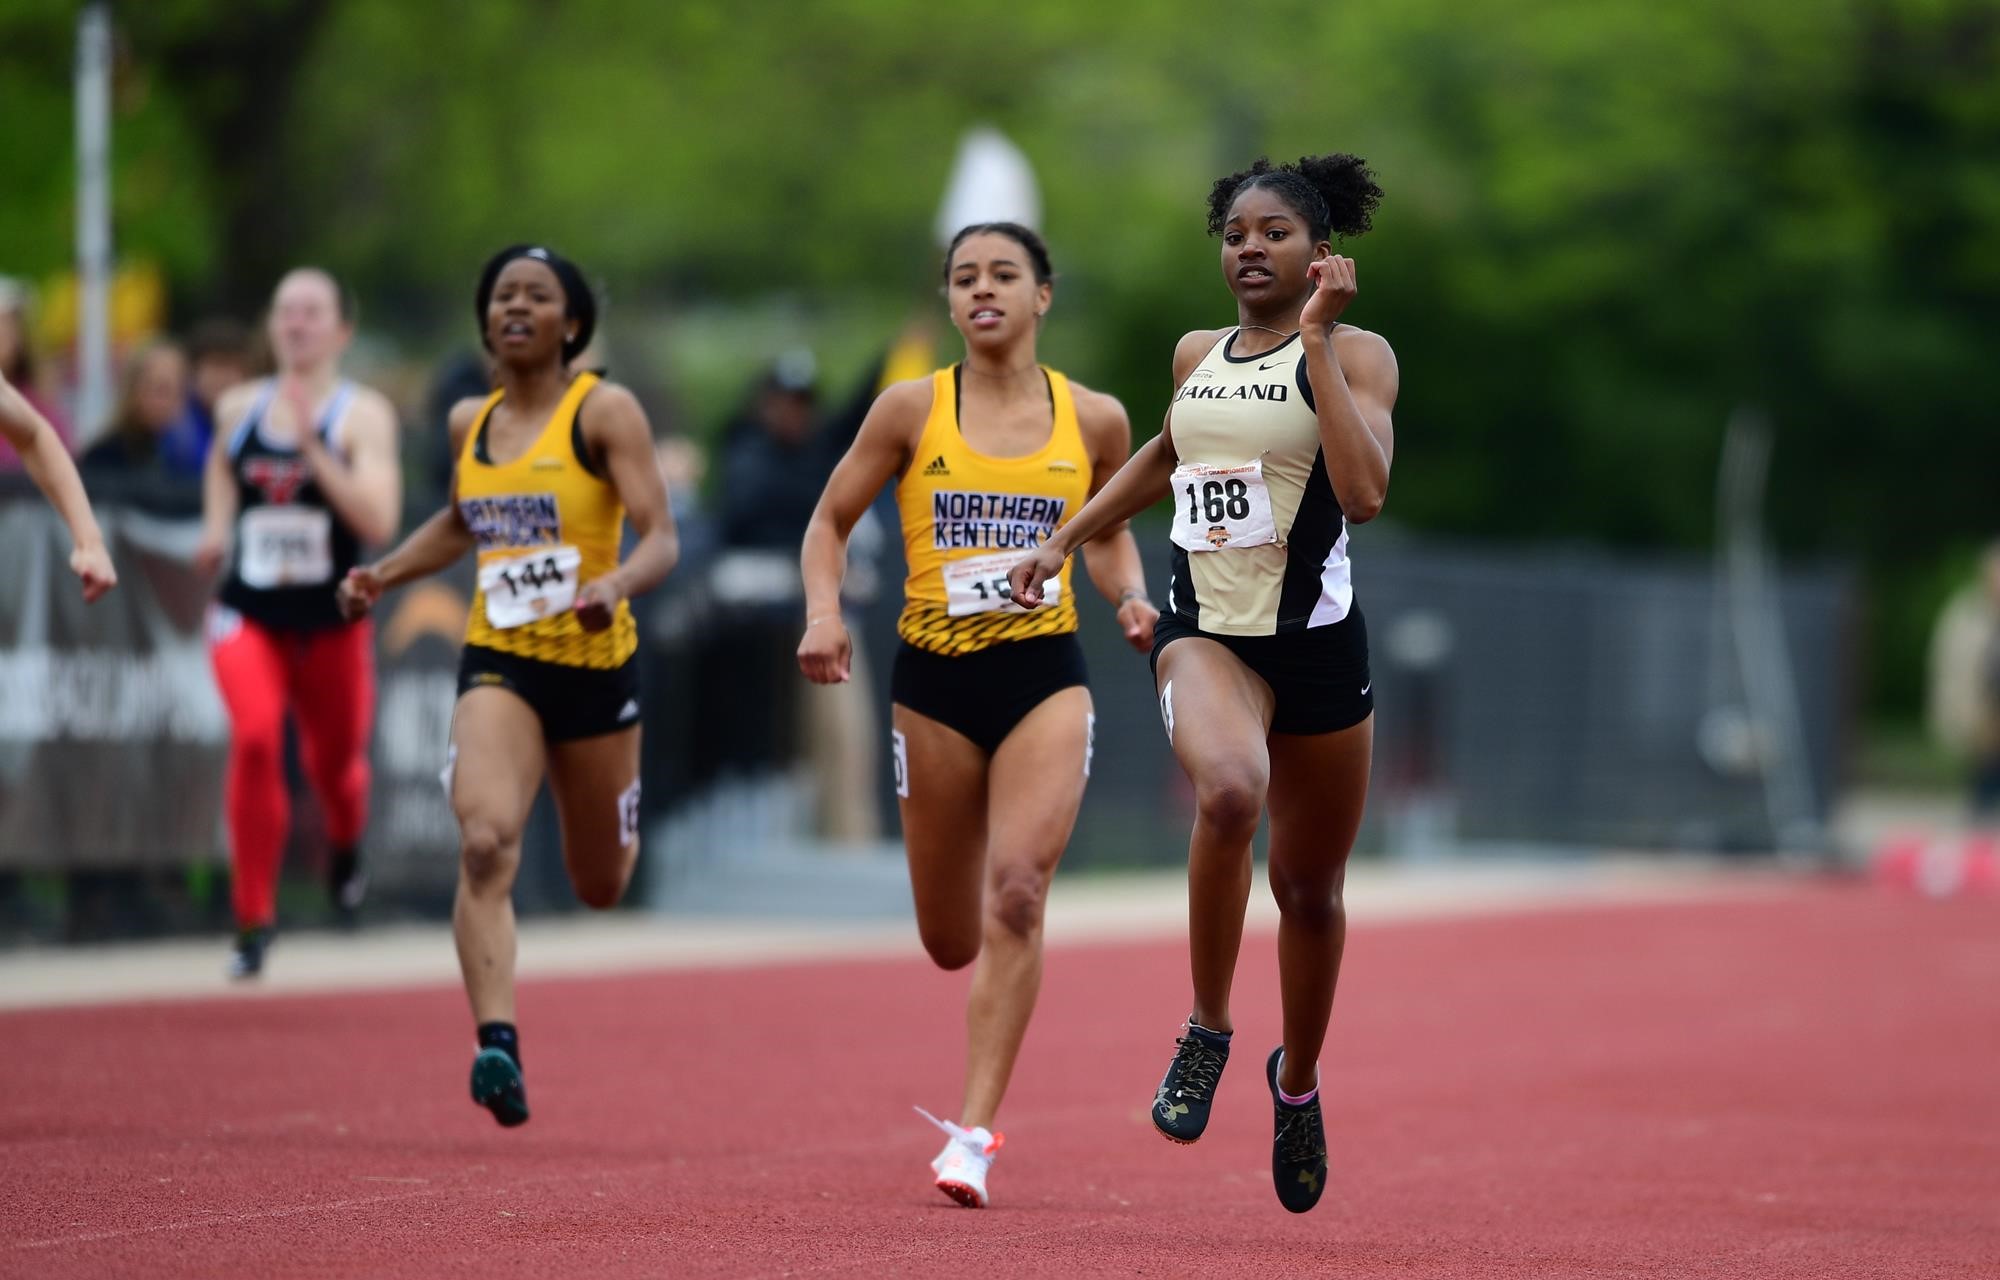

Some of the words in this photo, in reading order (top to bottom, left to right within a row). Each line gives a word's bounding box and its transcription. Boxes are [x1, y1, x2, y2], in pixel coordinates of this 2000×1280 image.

[934, 492, 1065, 525] NORTHERN
[1186, 478, 1250, 525] 168
[500, 557, 565, 598] 144
[971, 578, 1012, 600] 15
